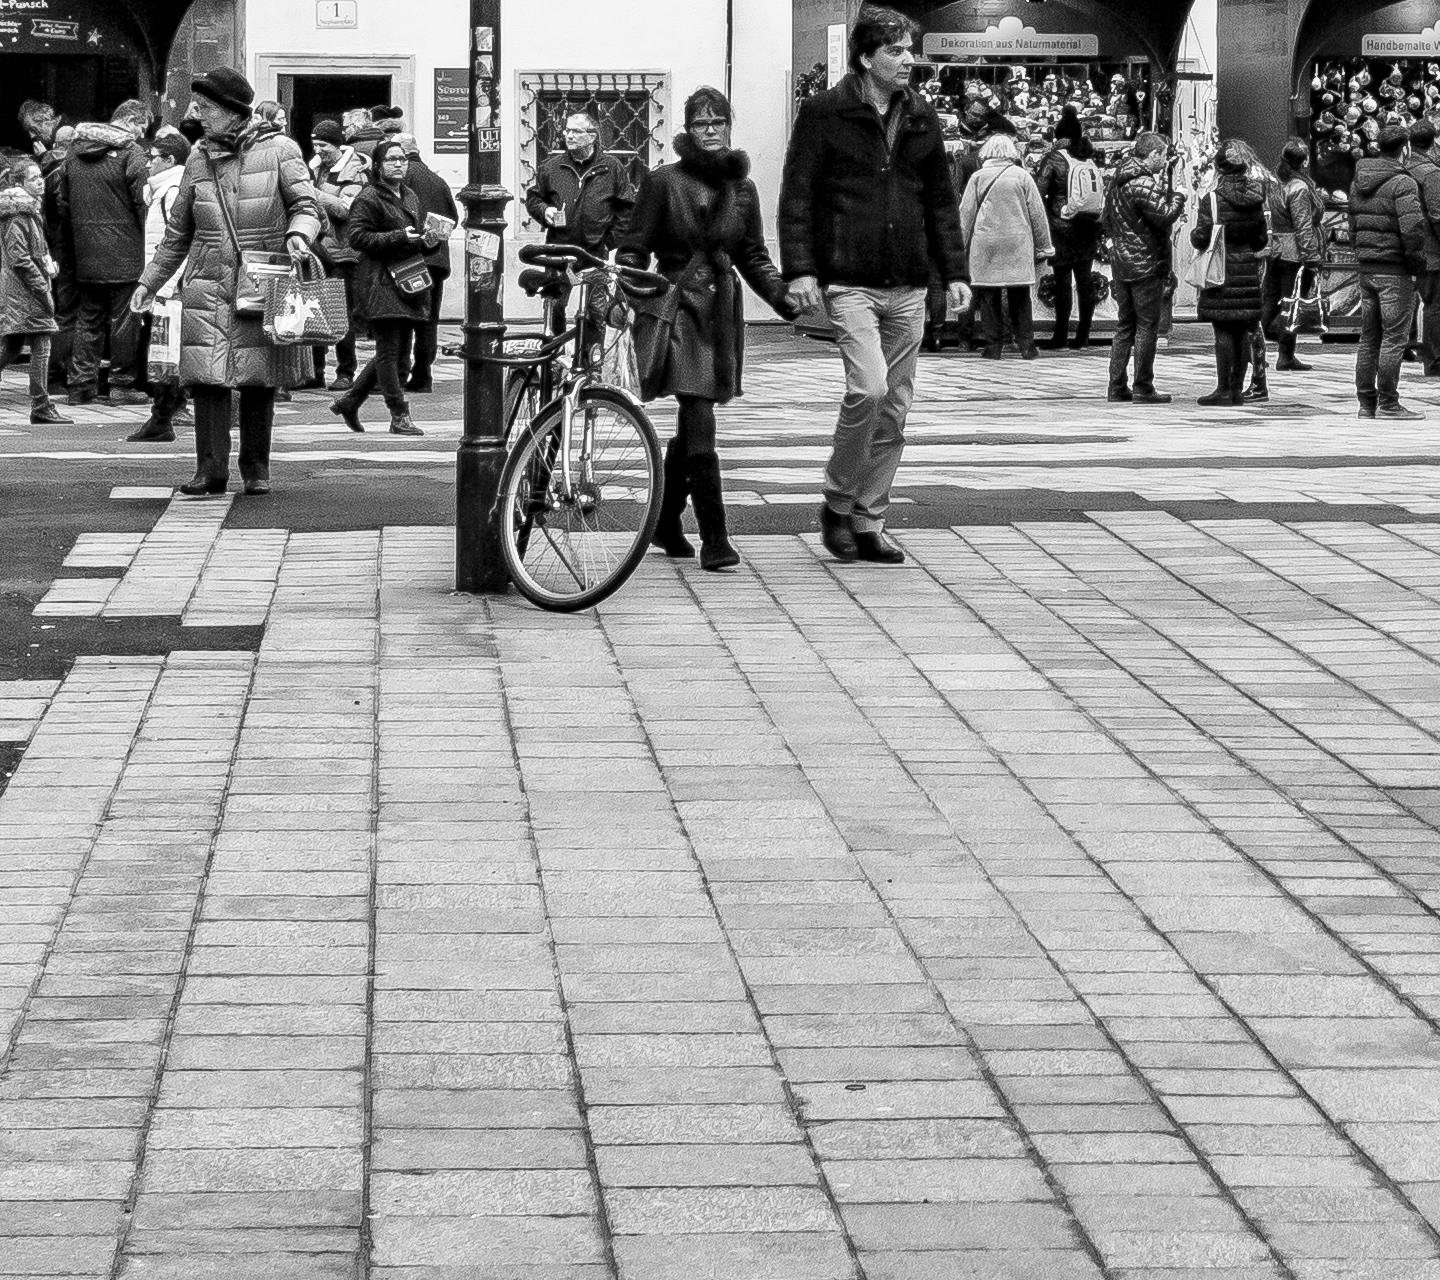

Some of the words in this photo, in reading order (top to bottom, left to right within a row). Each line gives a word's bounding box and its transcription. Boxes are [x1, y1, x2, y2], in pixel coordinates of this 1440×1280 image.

[332, 2, 340, 17] 1
[941, 37, 992, 48] Dekoration
[996, 40, 1012, 48] aus
[1015, 39, 1081, 49] Naturmaterial
[1366, 40, 1431, 51] Handbemalte
